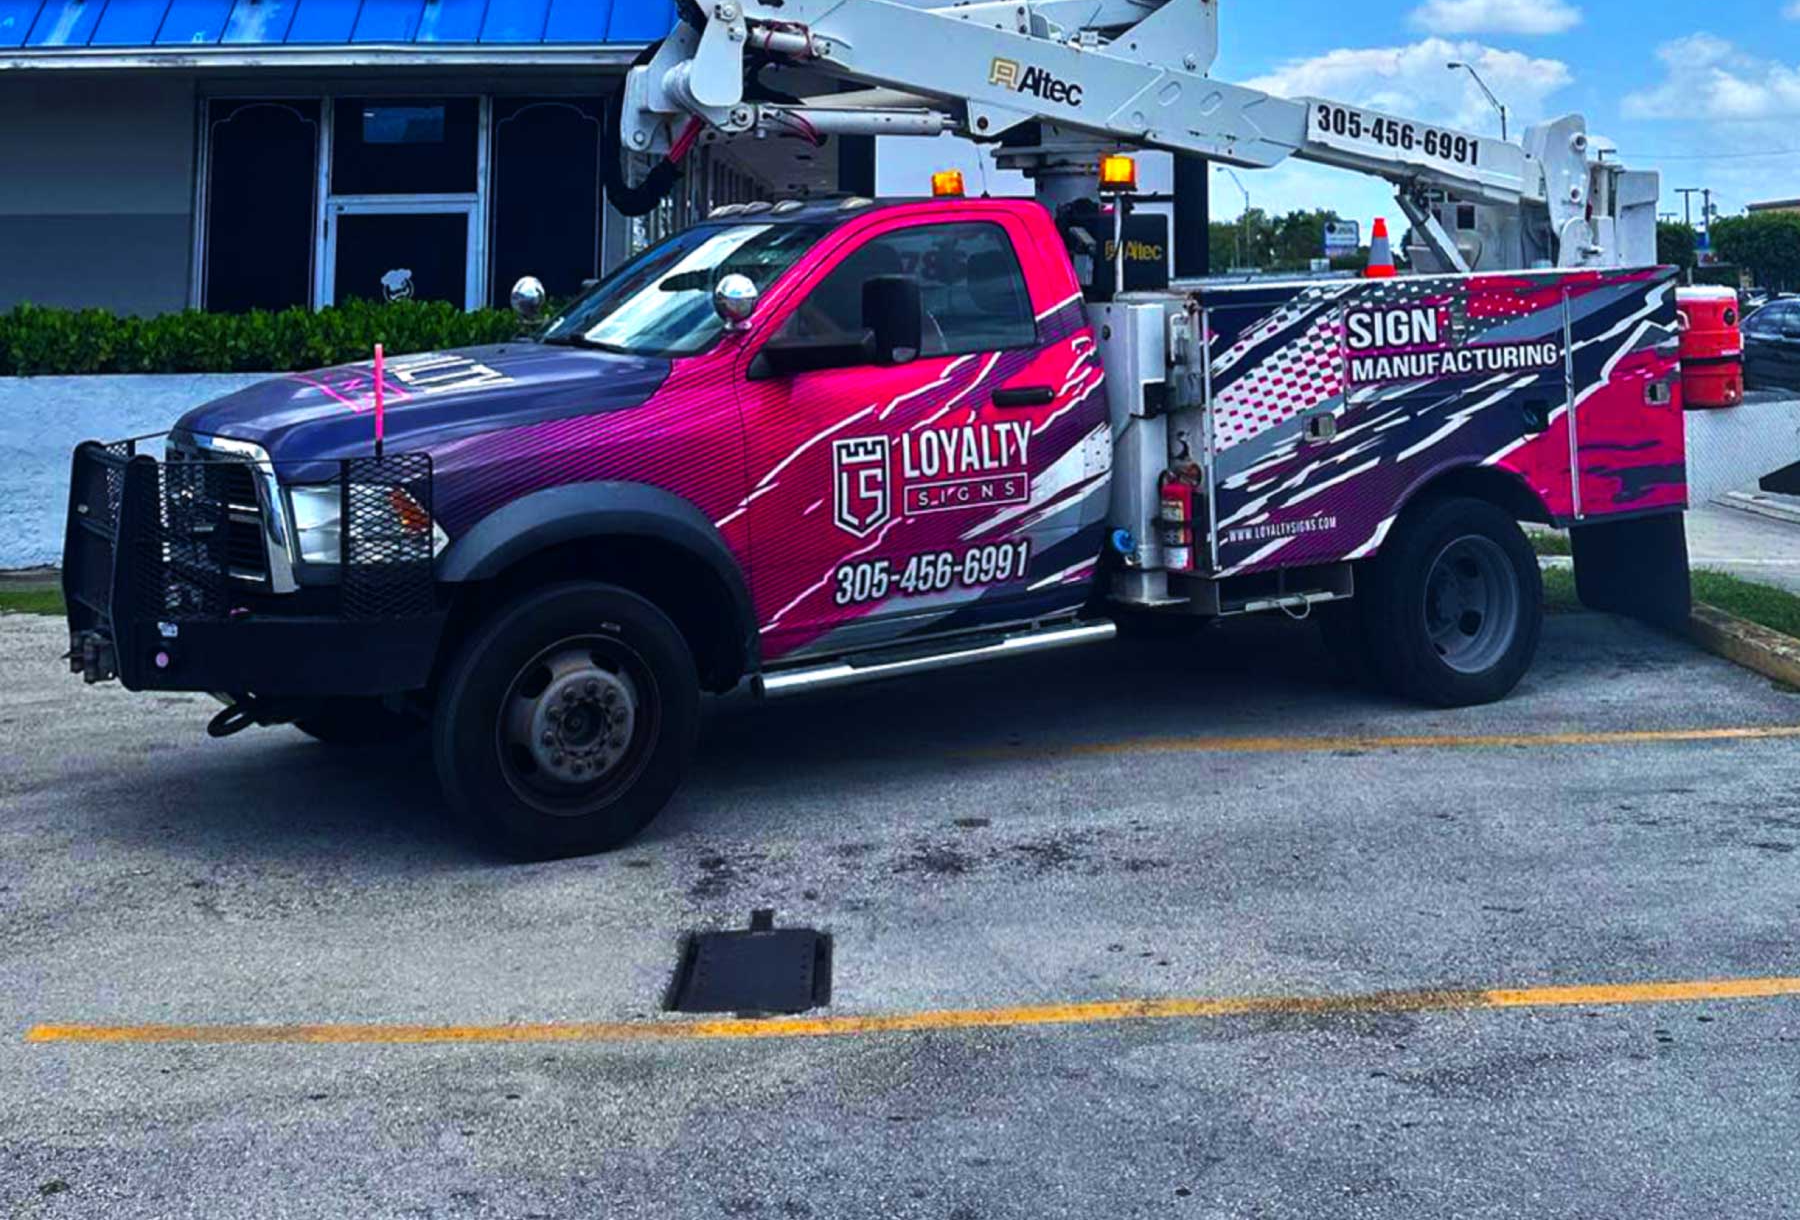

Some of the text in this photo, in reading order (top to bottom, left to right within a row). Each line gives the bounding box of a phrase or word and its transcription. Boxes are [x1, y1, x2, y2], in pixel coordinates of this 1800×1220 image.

[1017, 65, 1083, 106] Altec
[1317, 104, 1479, 166] 305-456-6991
[1348, 308, 1438, 349] SIGN
[1350, 343, 1559, 382] MANUFACTURING
[903, 421, 1032, 477] LOYALTY
[918, 482, 1015, 506] SIGNS
[836, 542, 1029, 603] 305-456-6991
